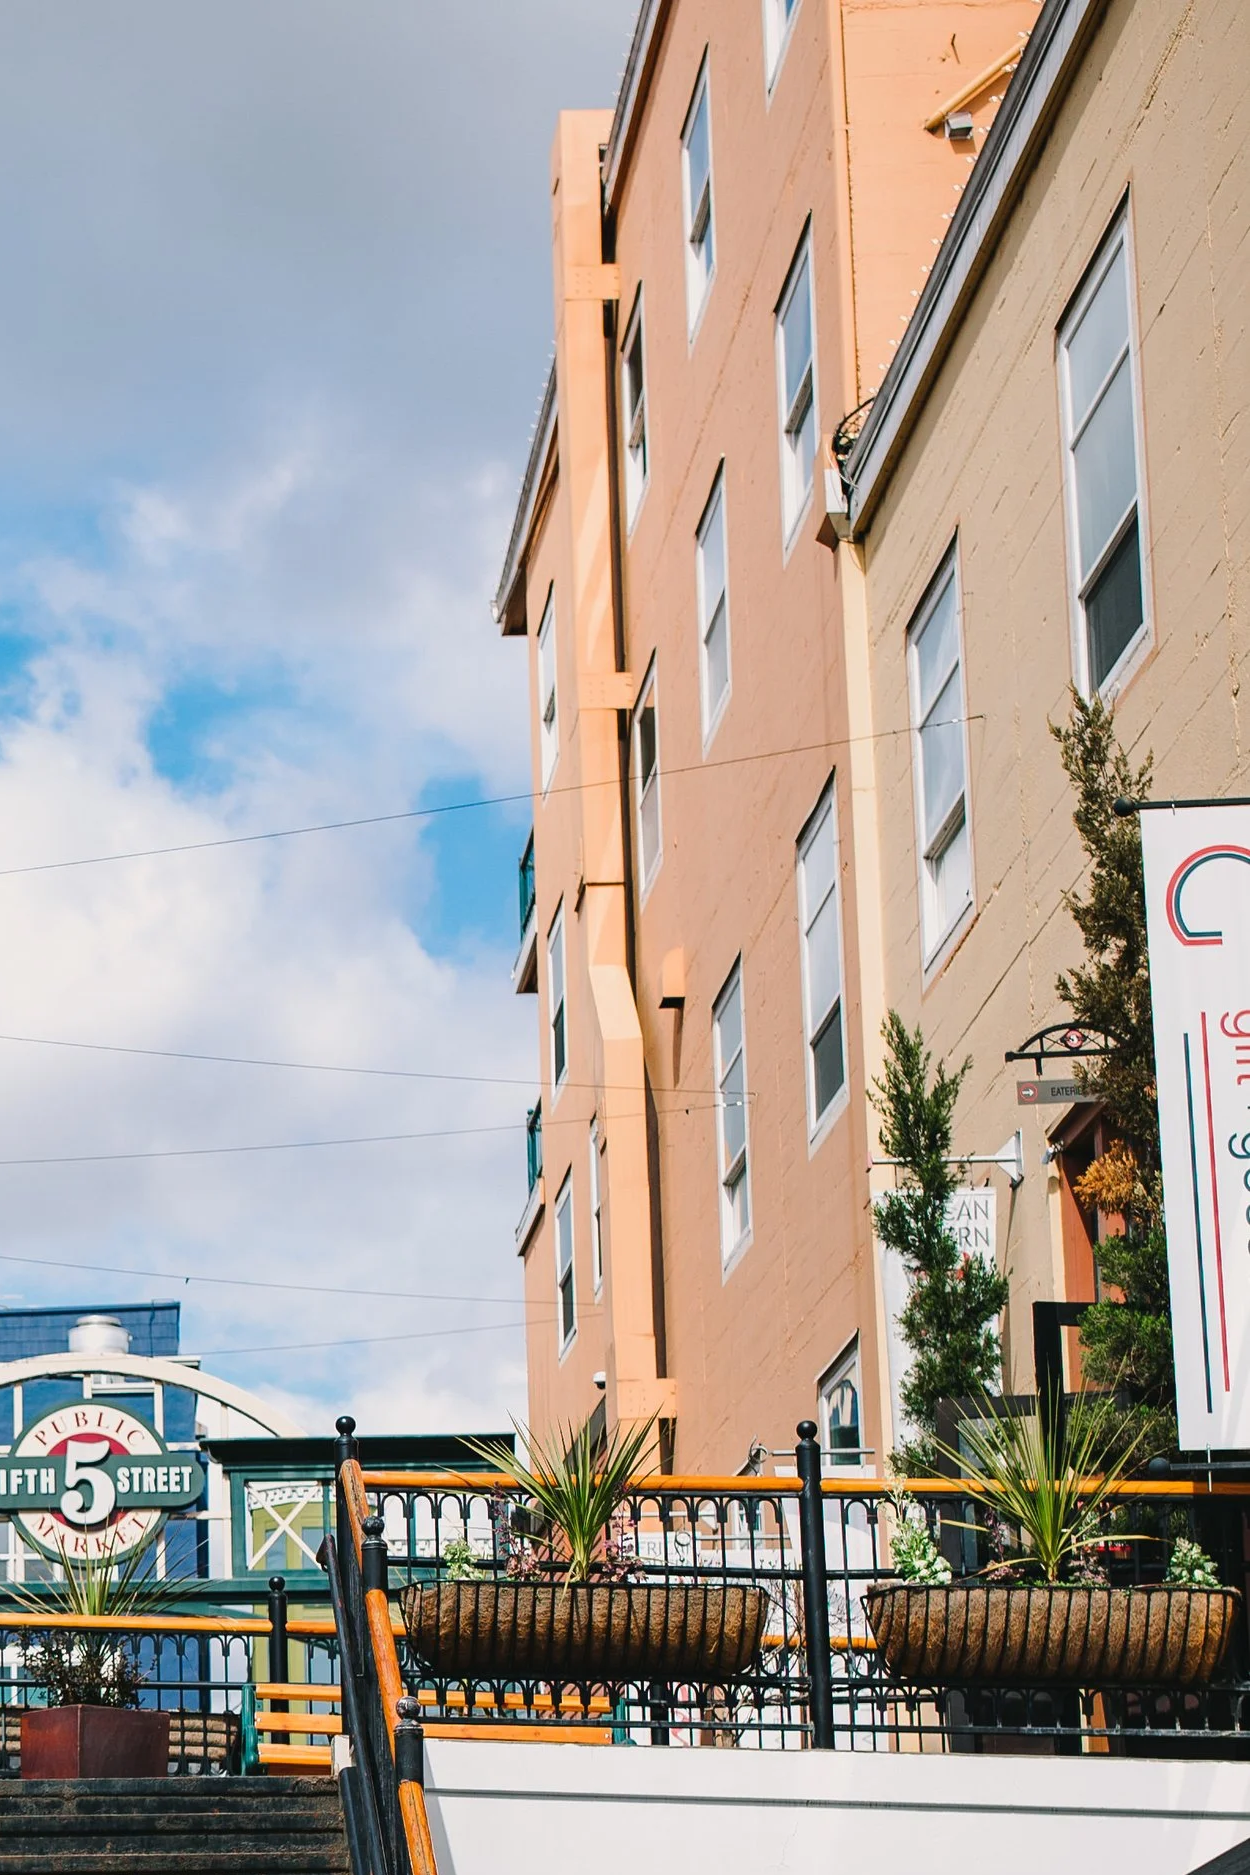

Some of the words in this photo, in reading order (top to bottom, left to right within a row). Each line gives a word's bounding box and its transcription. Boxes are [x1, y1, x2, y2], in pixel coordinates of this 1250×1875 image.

[34, 1411, 145, 1447] PUBLIC
[60, 1439, 116, 1525] 5
[116, 1466, 194, 1494] STREET
